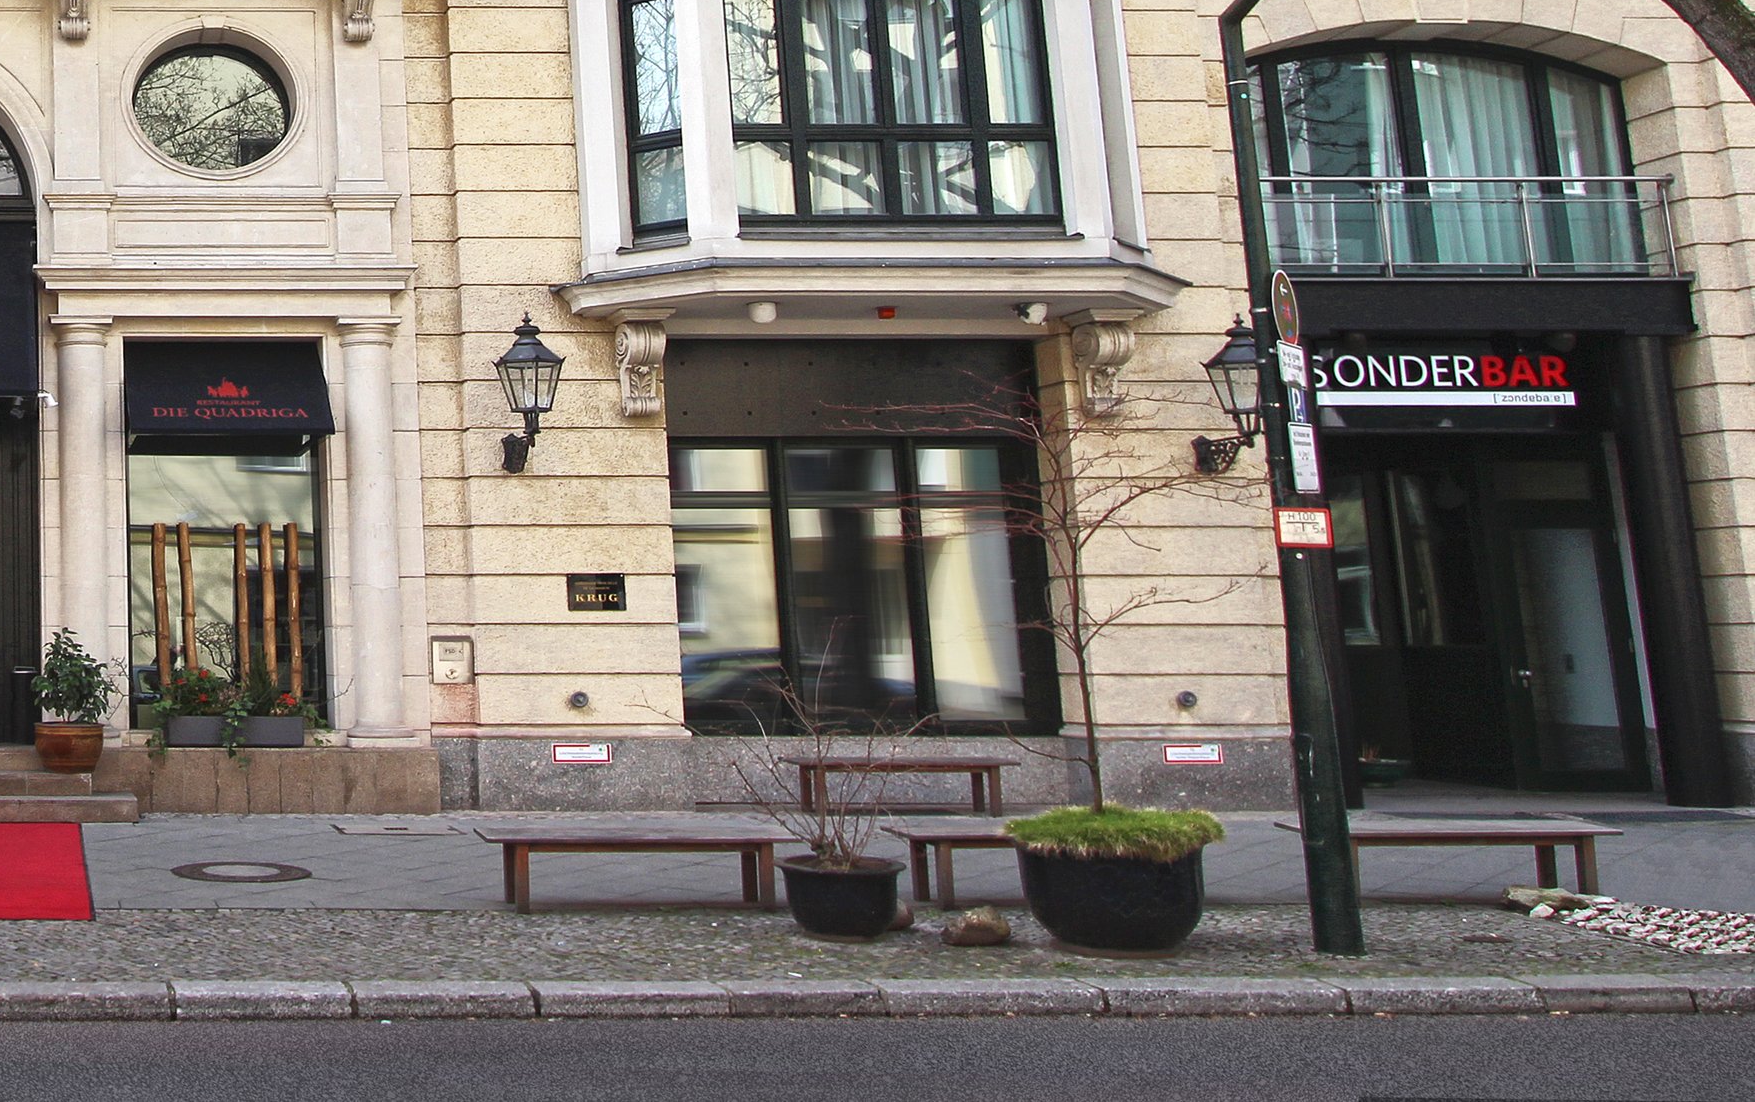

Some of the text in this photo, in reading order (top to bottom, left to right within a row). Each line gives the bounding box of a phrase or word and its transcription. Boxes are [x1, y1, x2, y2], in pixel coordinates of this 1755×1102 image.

[152, 407, 309, 419] DIE QUADRIGA
[575, 593, 618, 602] KRUG
